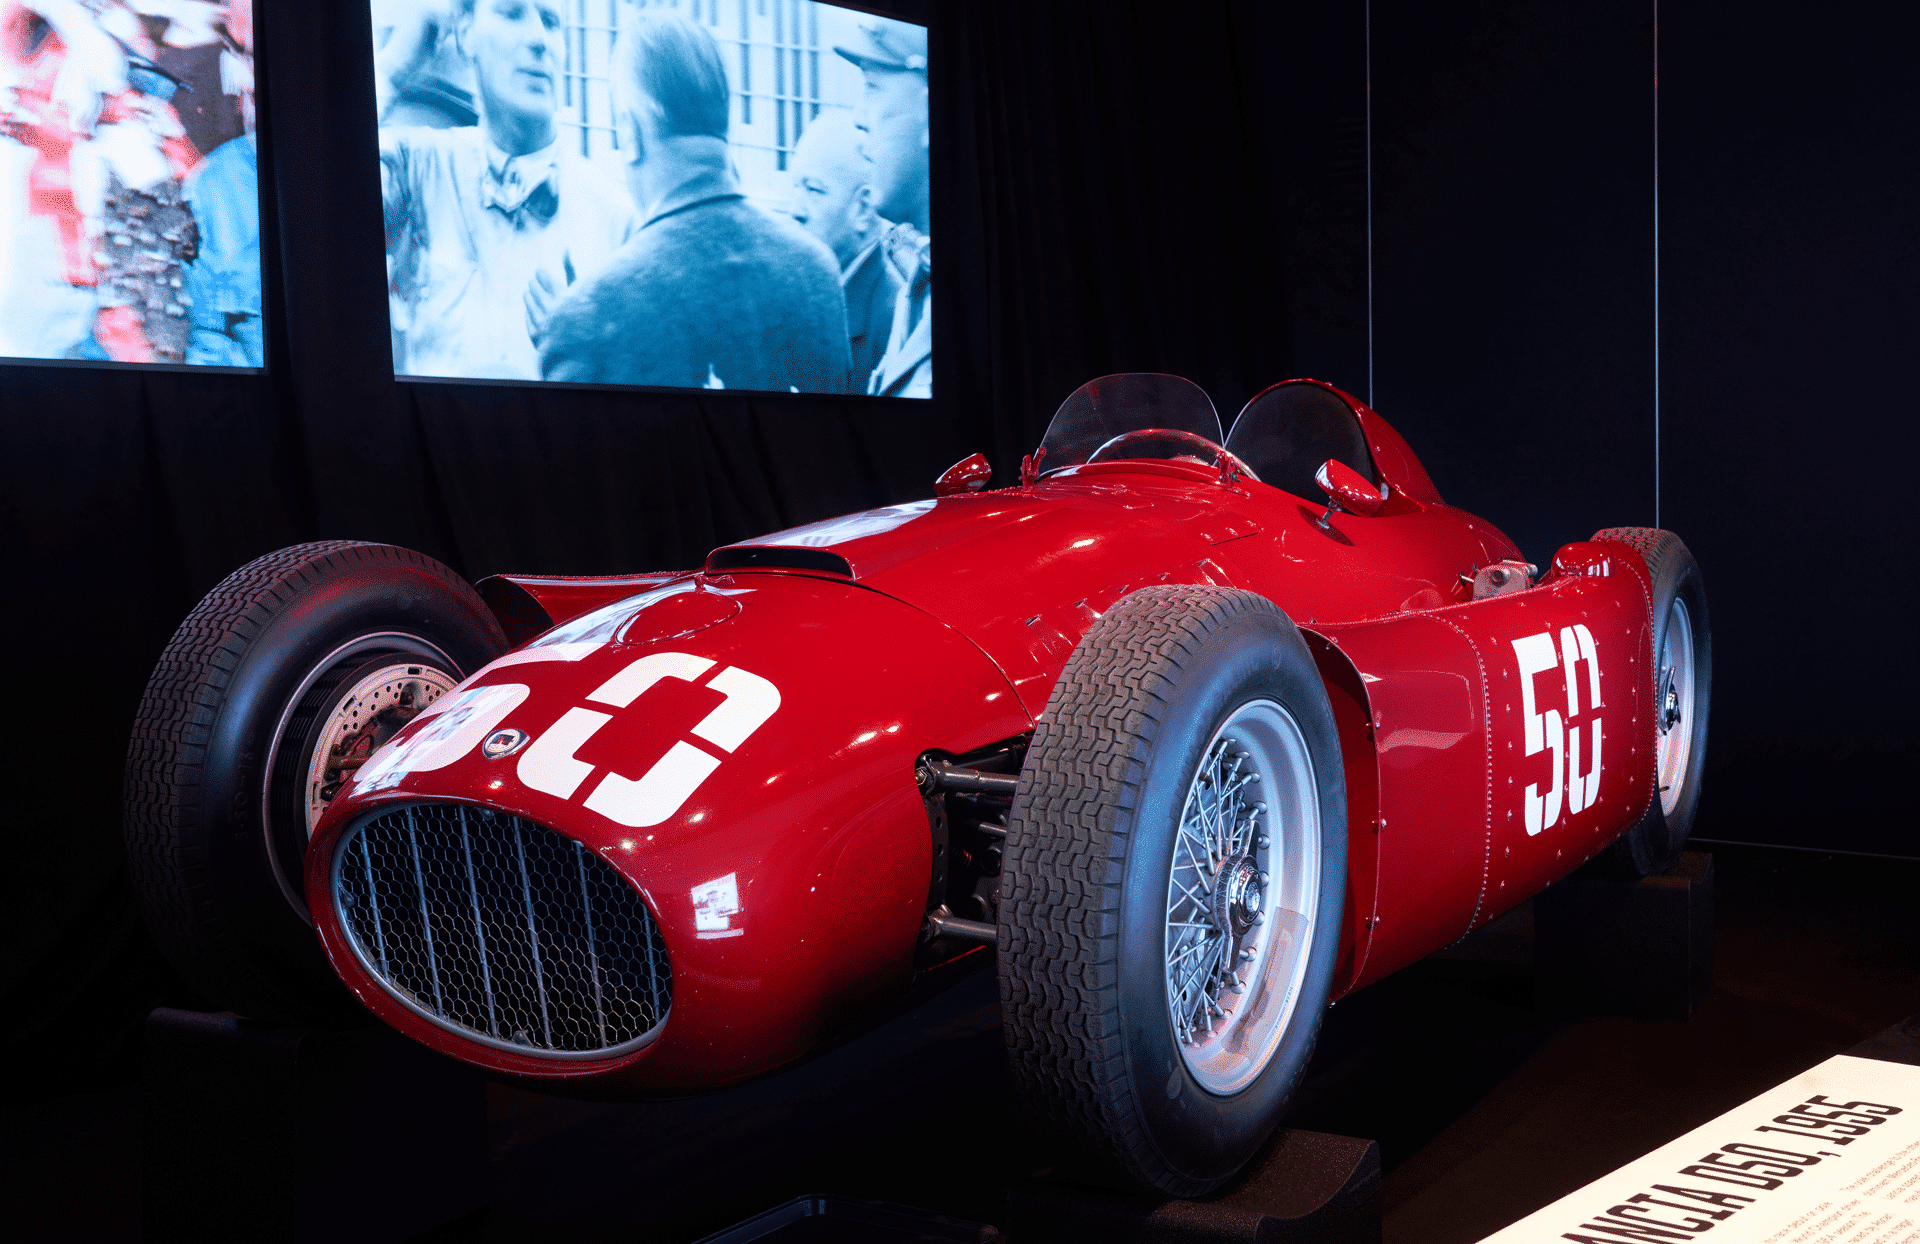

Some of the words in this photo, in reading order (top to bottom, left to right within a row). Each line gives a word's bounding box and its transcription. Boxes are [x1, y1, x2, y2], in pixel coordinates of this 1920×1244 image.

[353, 643, 781, 828] 50
[1511, 624, 1602, 837] 50
[1677, 1142, 1842, 1191] D50,
[1754, 1095, 1904, 1146] 1955
